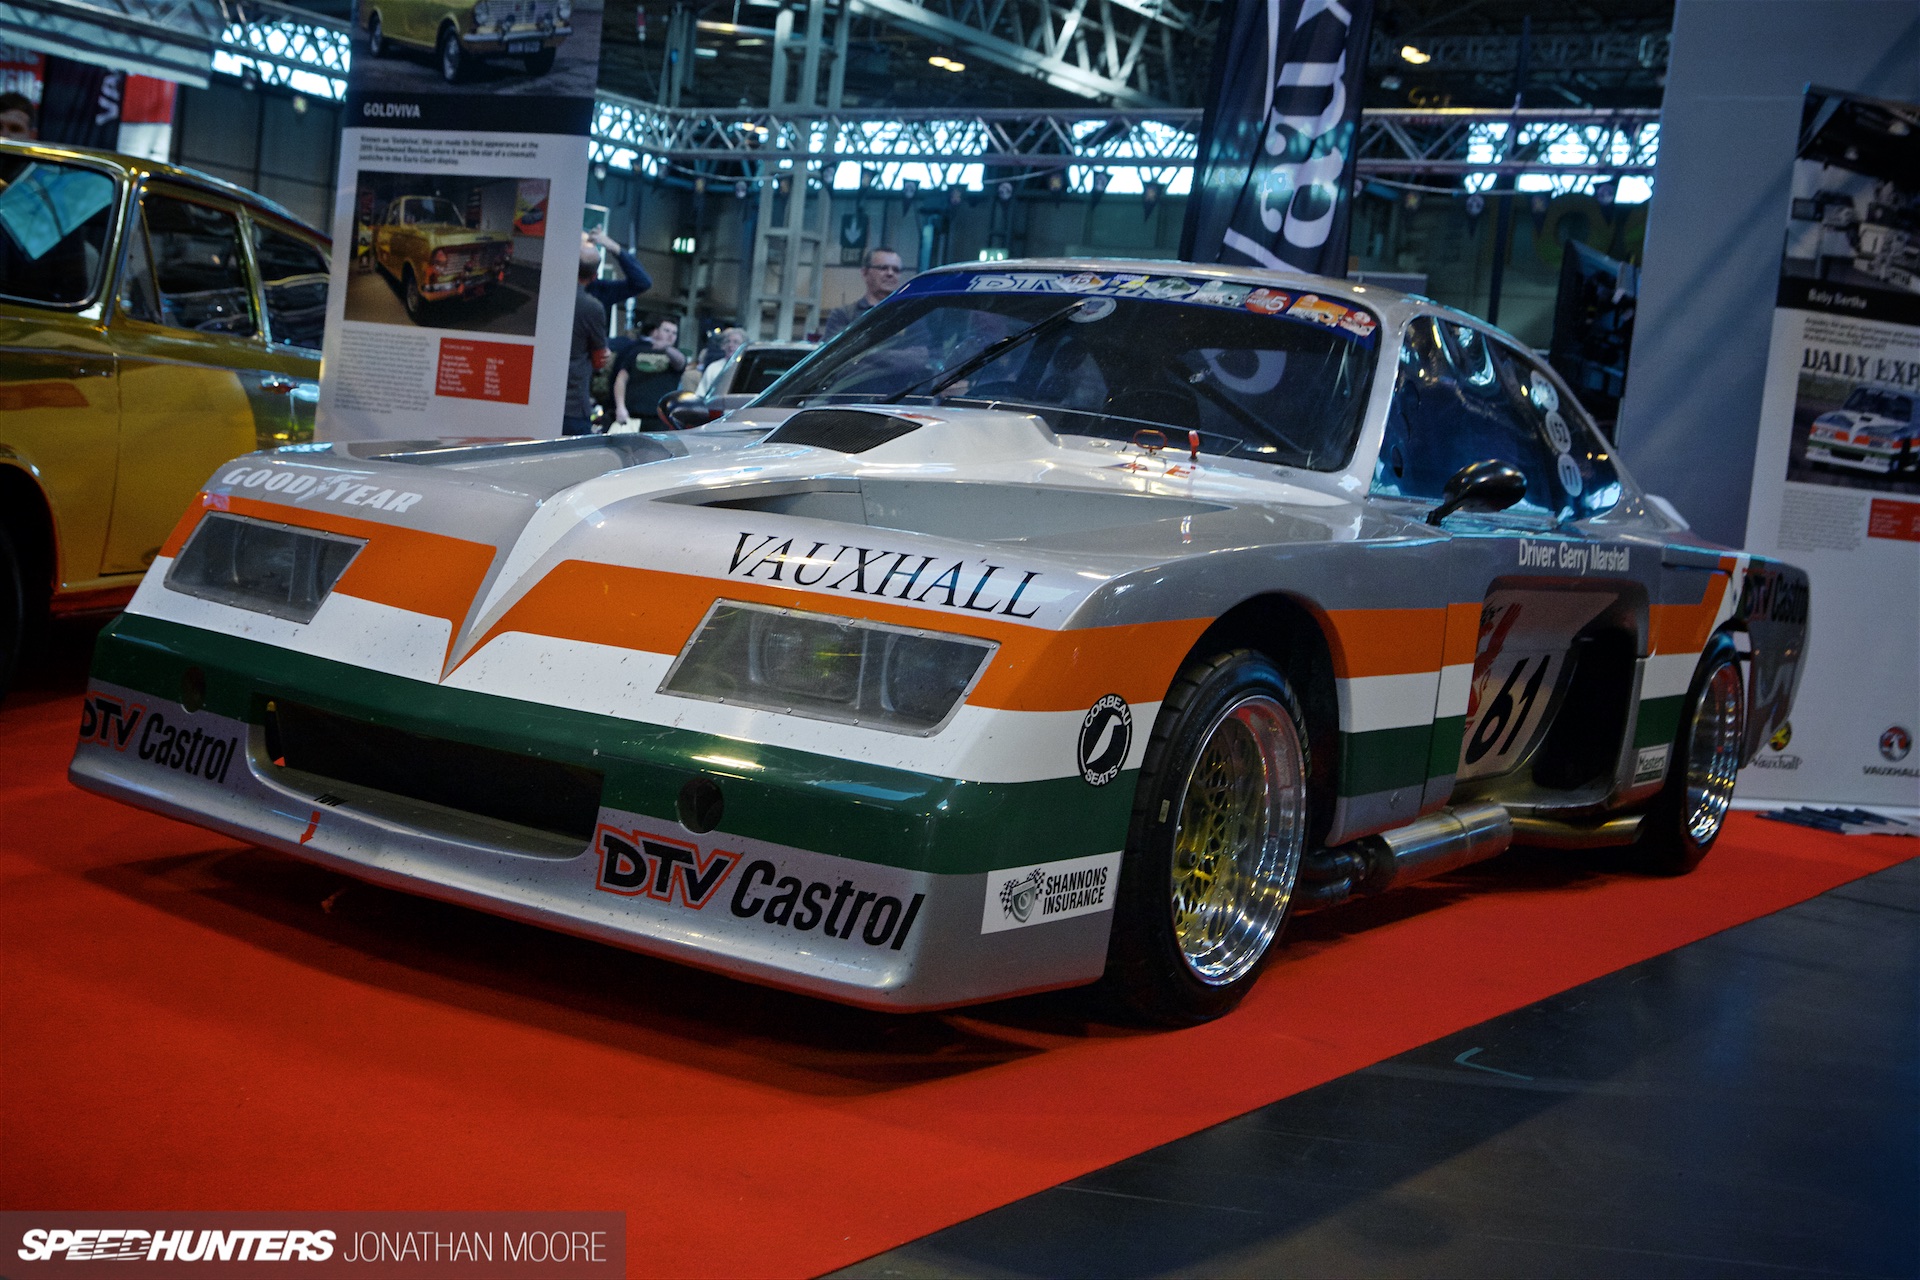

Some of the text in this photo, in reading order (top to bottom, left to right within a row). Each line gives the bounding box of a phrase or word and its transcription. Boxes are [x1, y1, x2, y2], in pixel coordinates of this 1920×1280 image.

[363, 102, 421, 118] GOLDVIVA
[1265, 295, 1288, 311] 5
[1801, 348, 1870, 379] DAILY
[222, 467, 423, 513] GOODYEAR
[1518, 538, 1631, 576] Driver: Gerry Marshall
[728, 531, 1044, 619] VAUXHALL
[1084, 694, 1132, 729] CORBEAU
[1464, 654, 1551, 765] 61
[138, 712, 238, 784] Castrol
[1084, 764, 1118, 787] SEATS
[598, 828, 926, 951] DTV Castrol
[1045, 866, 1109, 896] SHANNONS
[1042, 885, 1106, 915] INSURANCE
